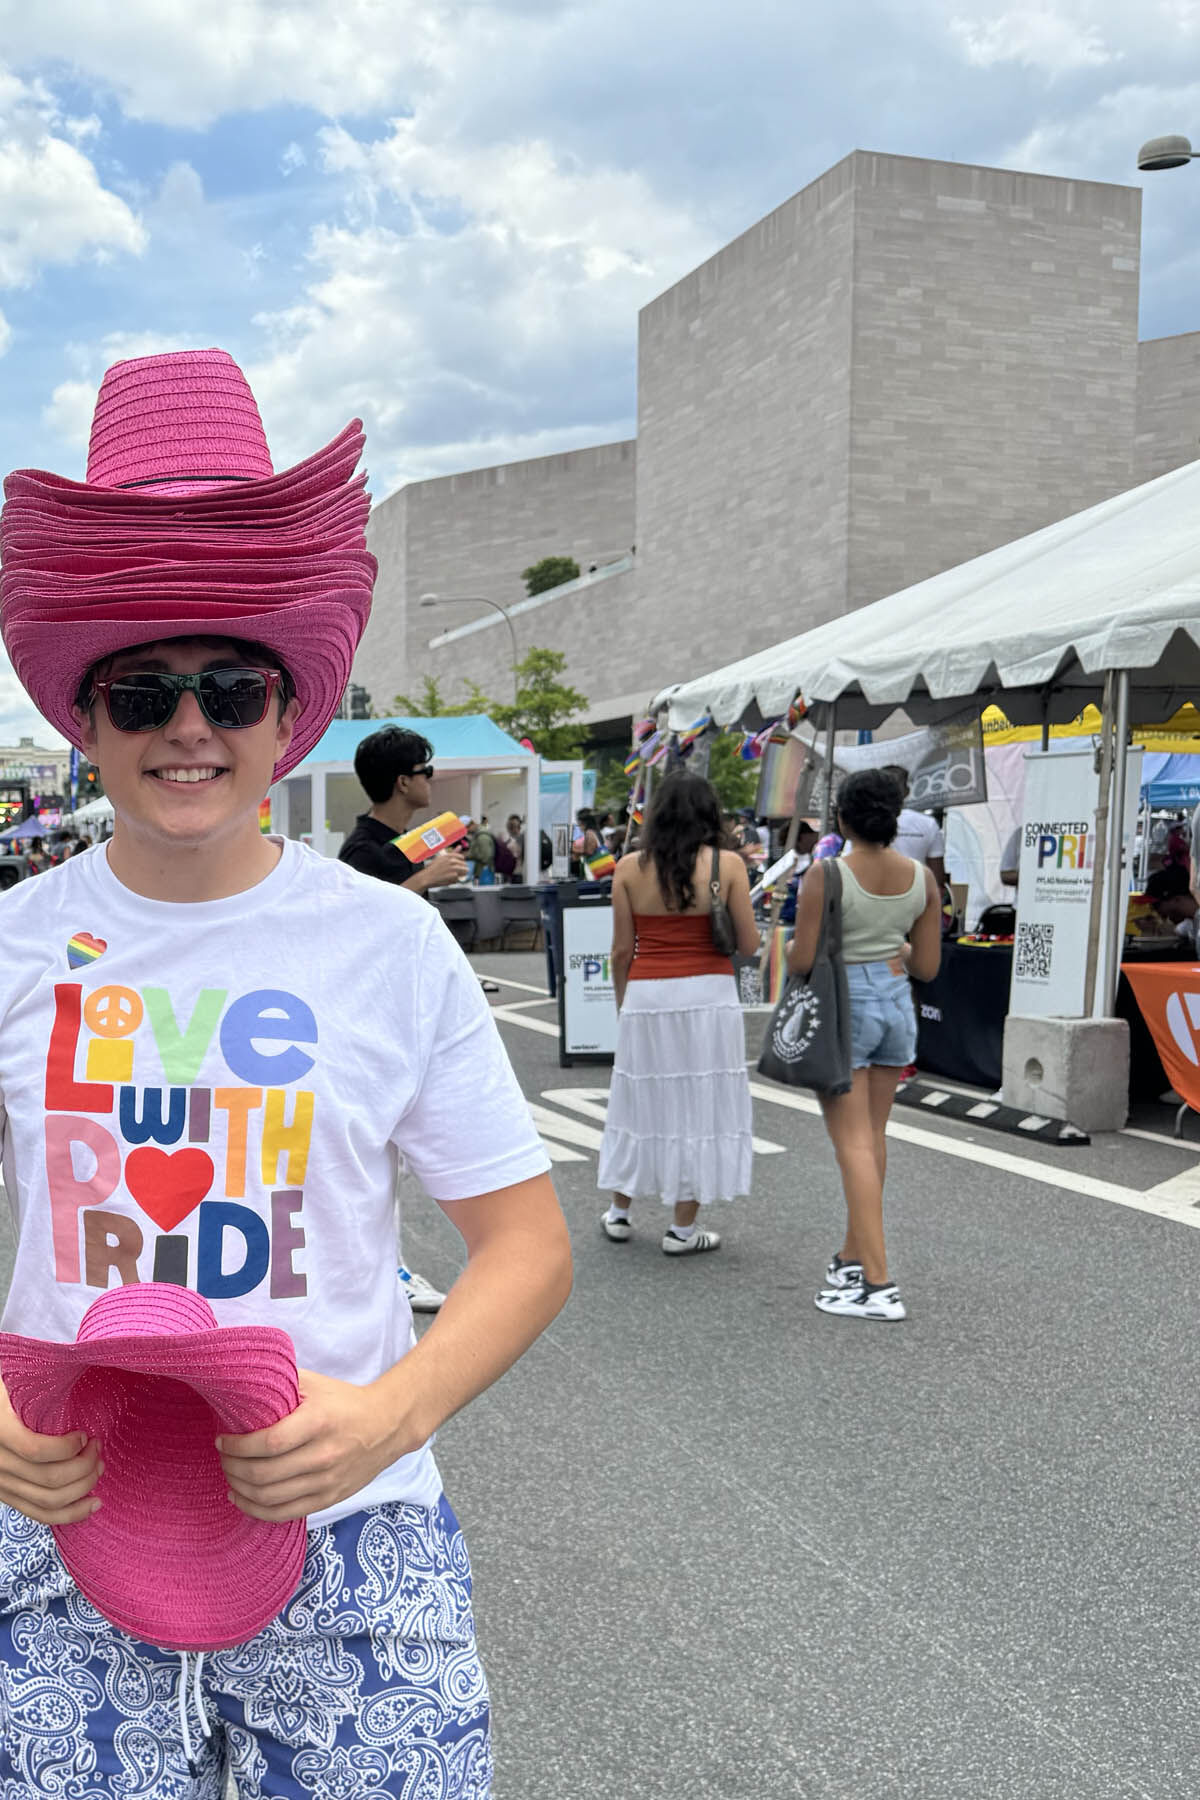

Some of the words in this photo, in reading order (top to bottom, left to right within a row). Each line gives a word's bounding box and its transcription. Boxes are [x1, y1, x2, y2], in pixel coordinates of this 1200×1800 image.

[1025, 822, 1089, 835] CONNECTED
[1025, 835, 1038, 847] BY
[119, 1086, 315, 1197] WITH
